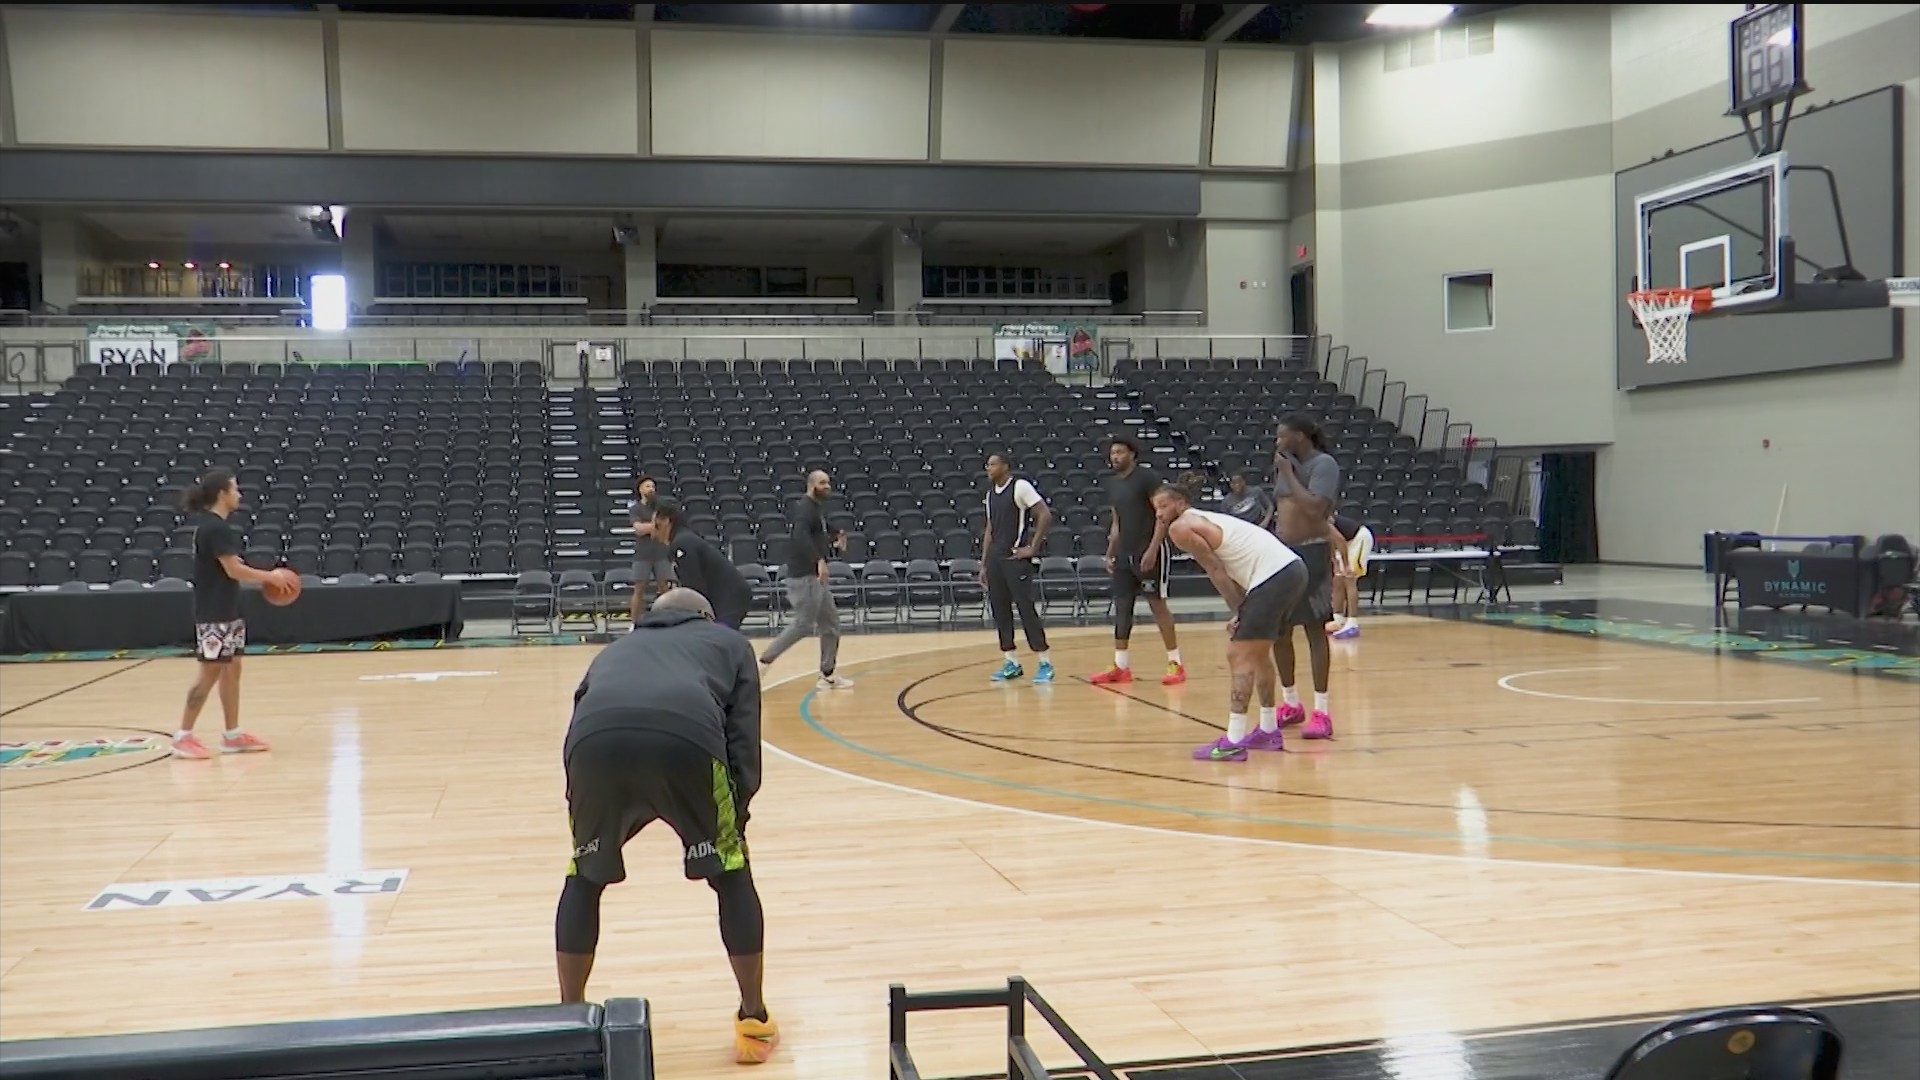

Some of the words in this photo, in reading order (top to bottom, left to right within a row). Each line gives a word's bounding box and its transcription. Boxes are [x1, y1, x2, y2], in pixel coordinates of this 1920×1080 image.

[100, 347, 166, 364] RYAN
[1764, 581, 1827, 594] DYNAMIC
[87, 877, 402, 909] RYAN
